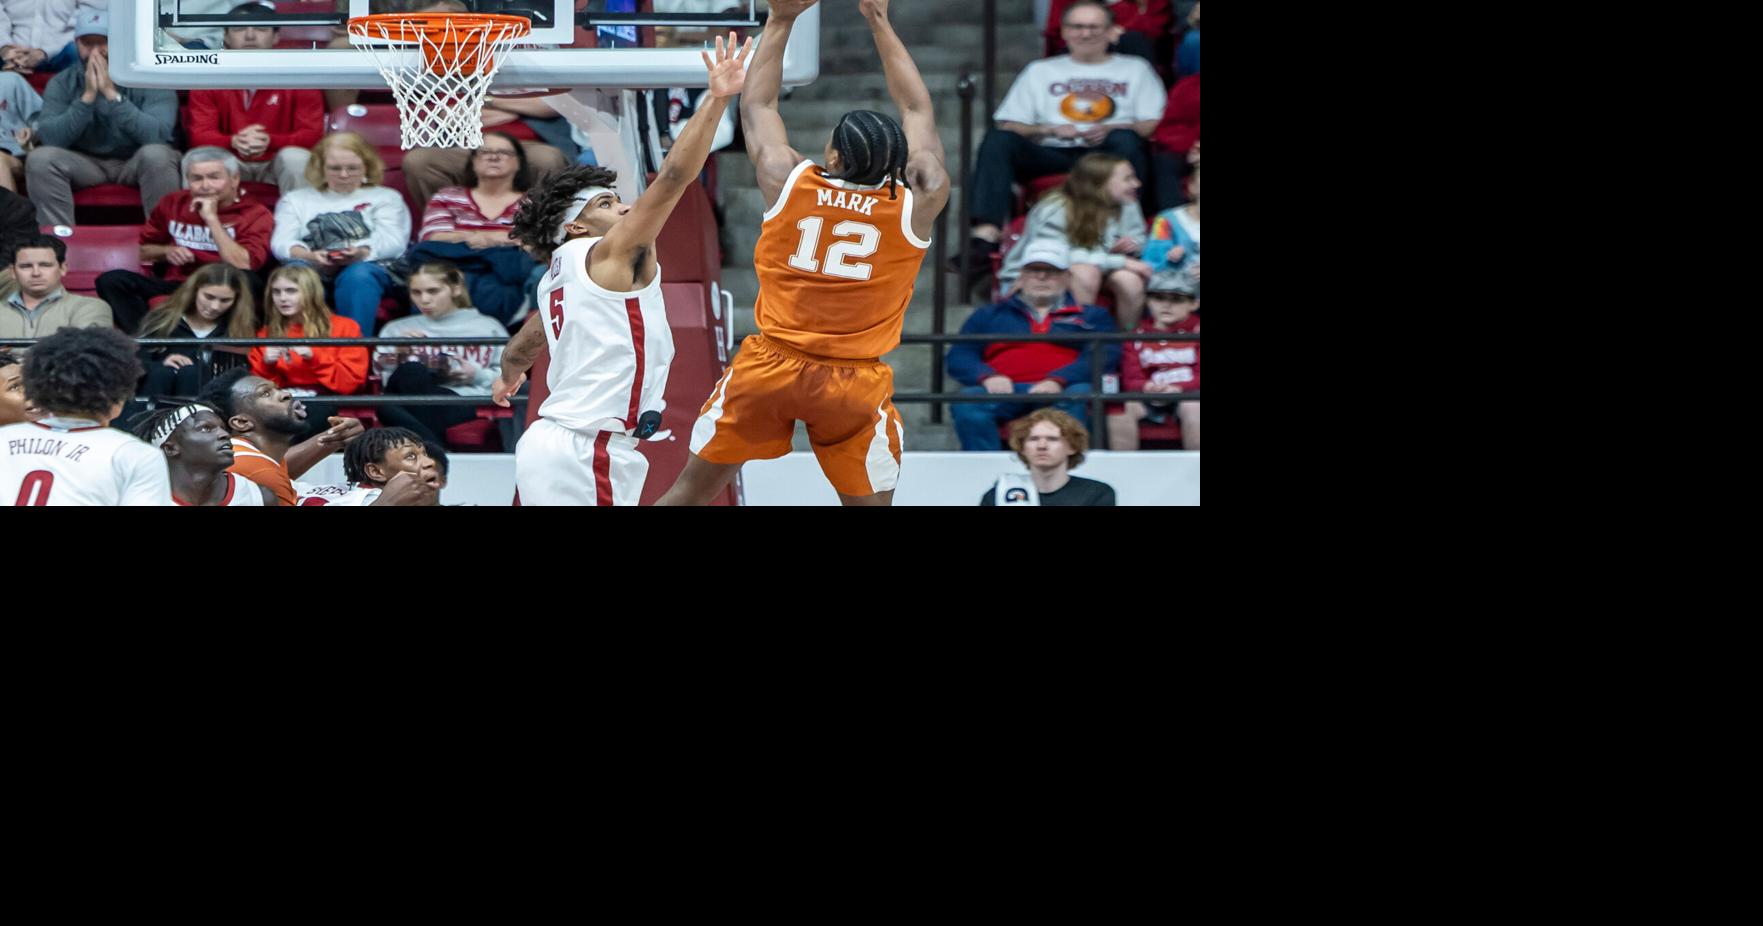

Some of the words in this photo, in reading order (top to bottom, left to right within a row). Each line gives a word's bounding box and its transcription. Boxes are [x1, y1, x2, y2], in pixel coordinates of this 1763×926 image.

[155, 53, 219, 65] SPALDING
[816, 188, 879, 216] MARK
[788, 215, 882, 281] 12
[549, 286, 564, 341] 5
[8, 437, 68, 456] PHILON
